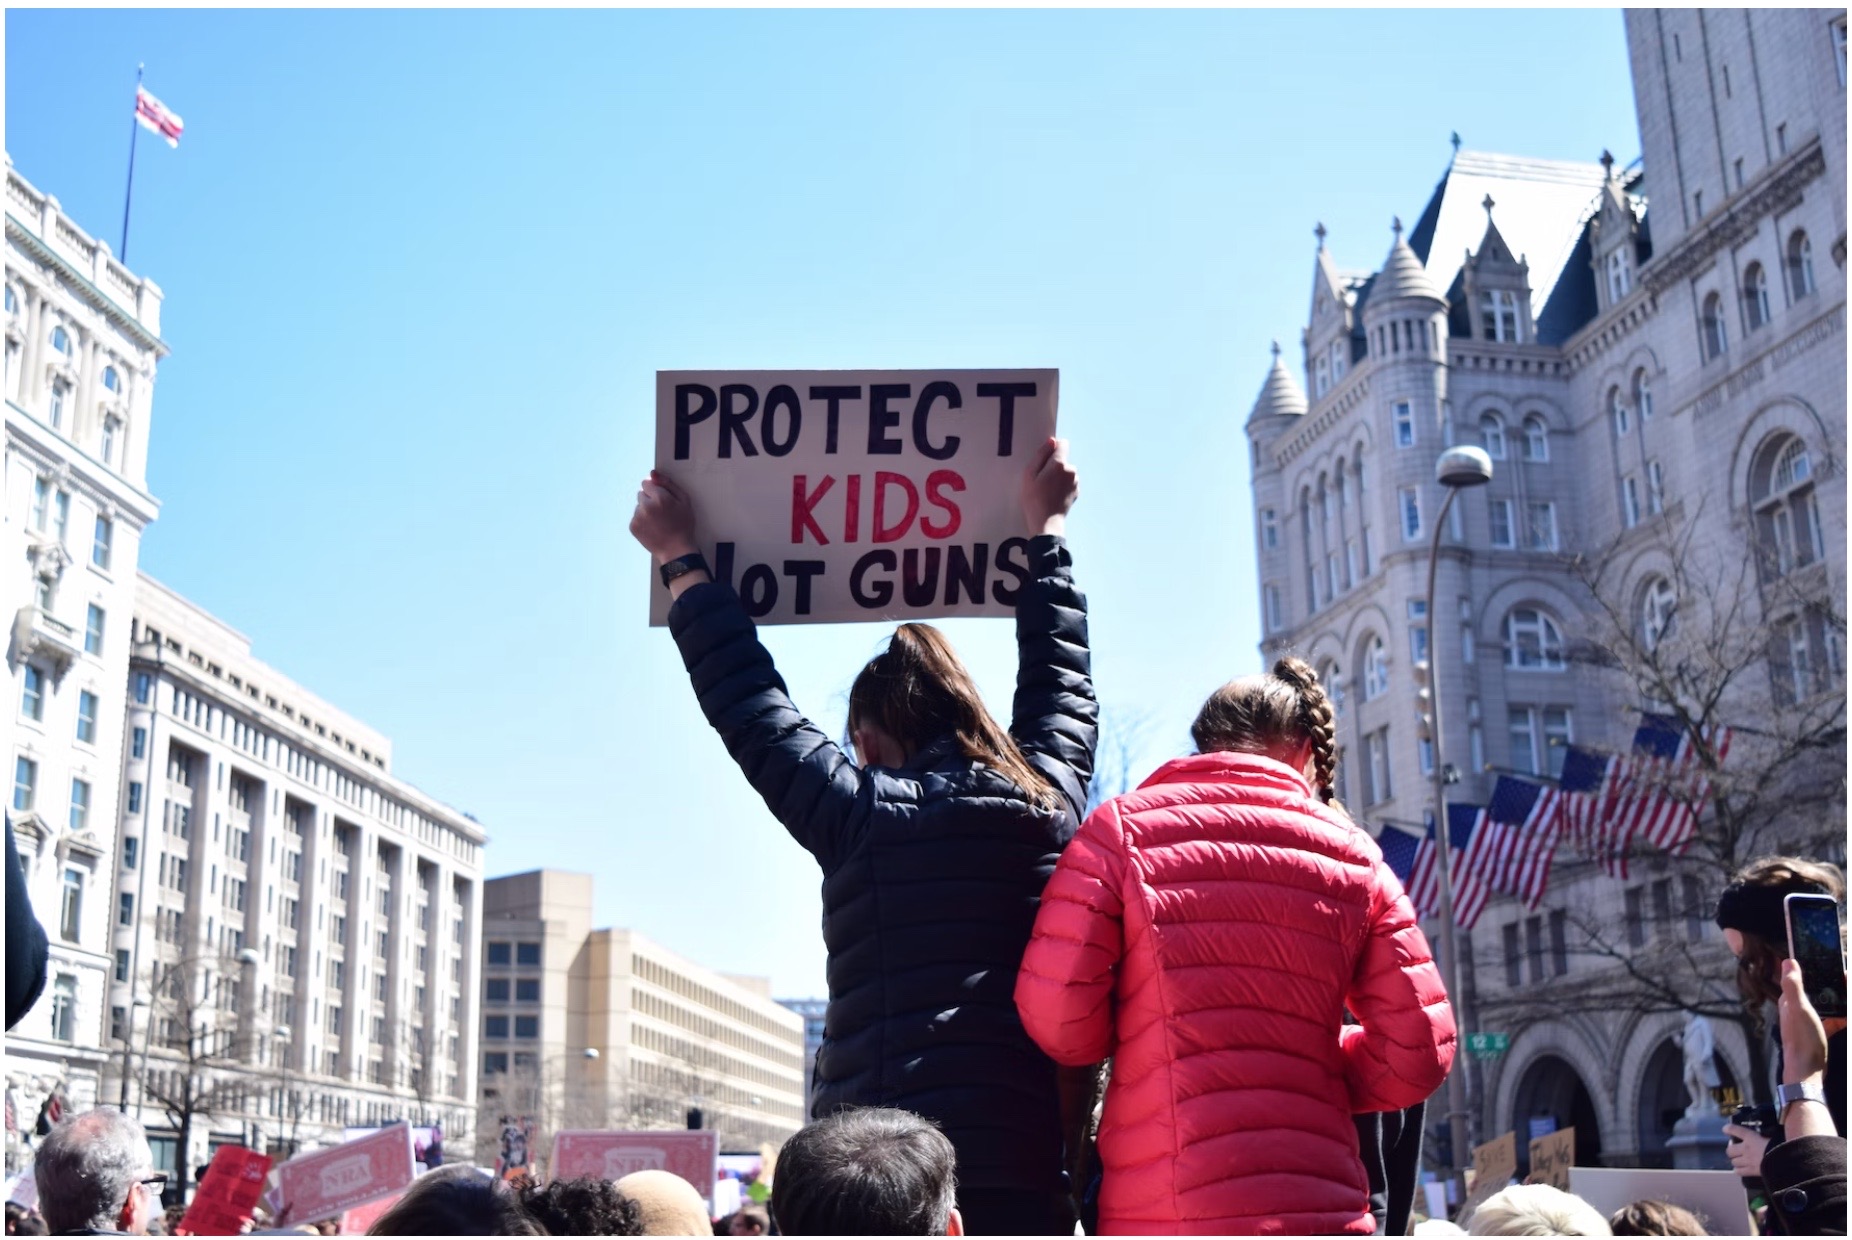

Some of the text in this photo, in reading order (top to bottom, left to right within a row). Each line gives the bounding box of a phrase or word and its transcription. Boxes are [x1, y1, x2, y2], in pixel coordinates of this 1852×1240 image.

[674, 381, 1037, 460] PROTECT
[791, 470, 967, 546] KIDS
[849, 536, 1031, 609] GUNS
